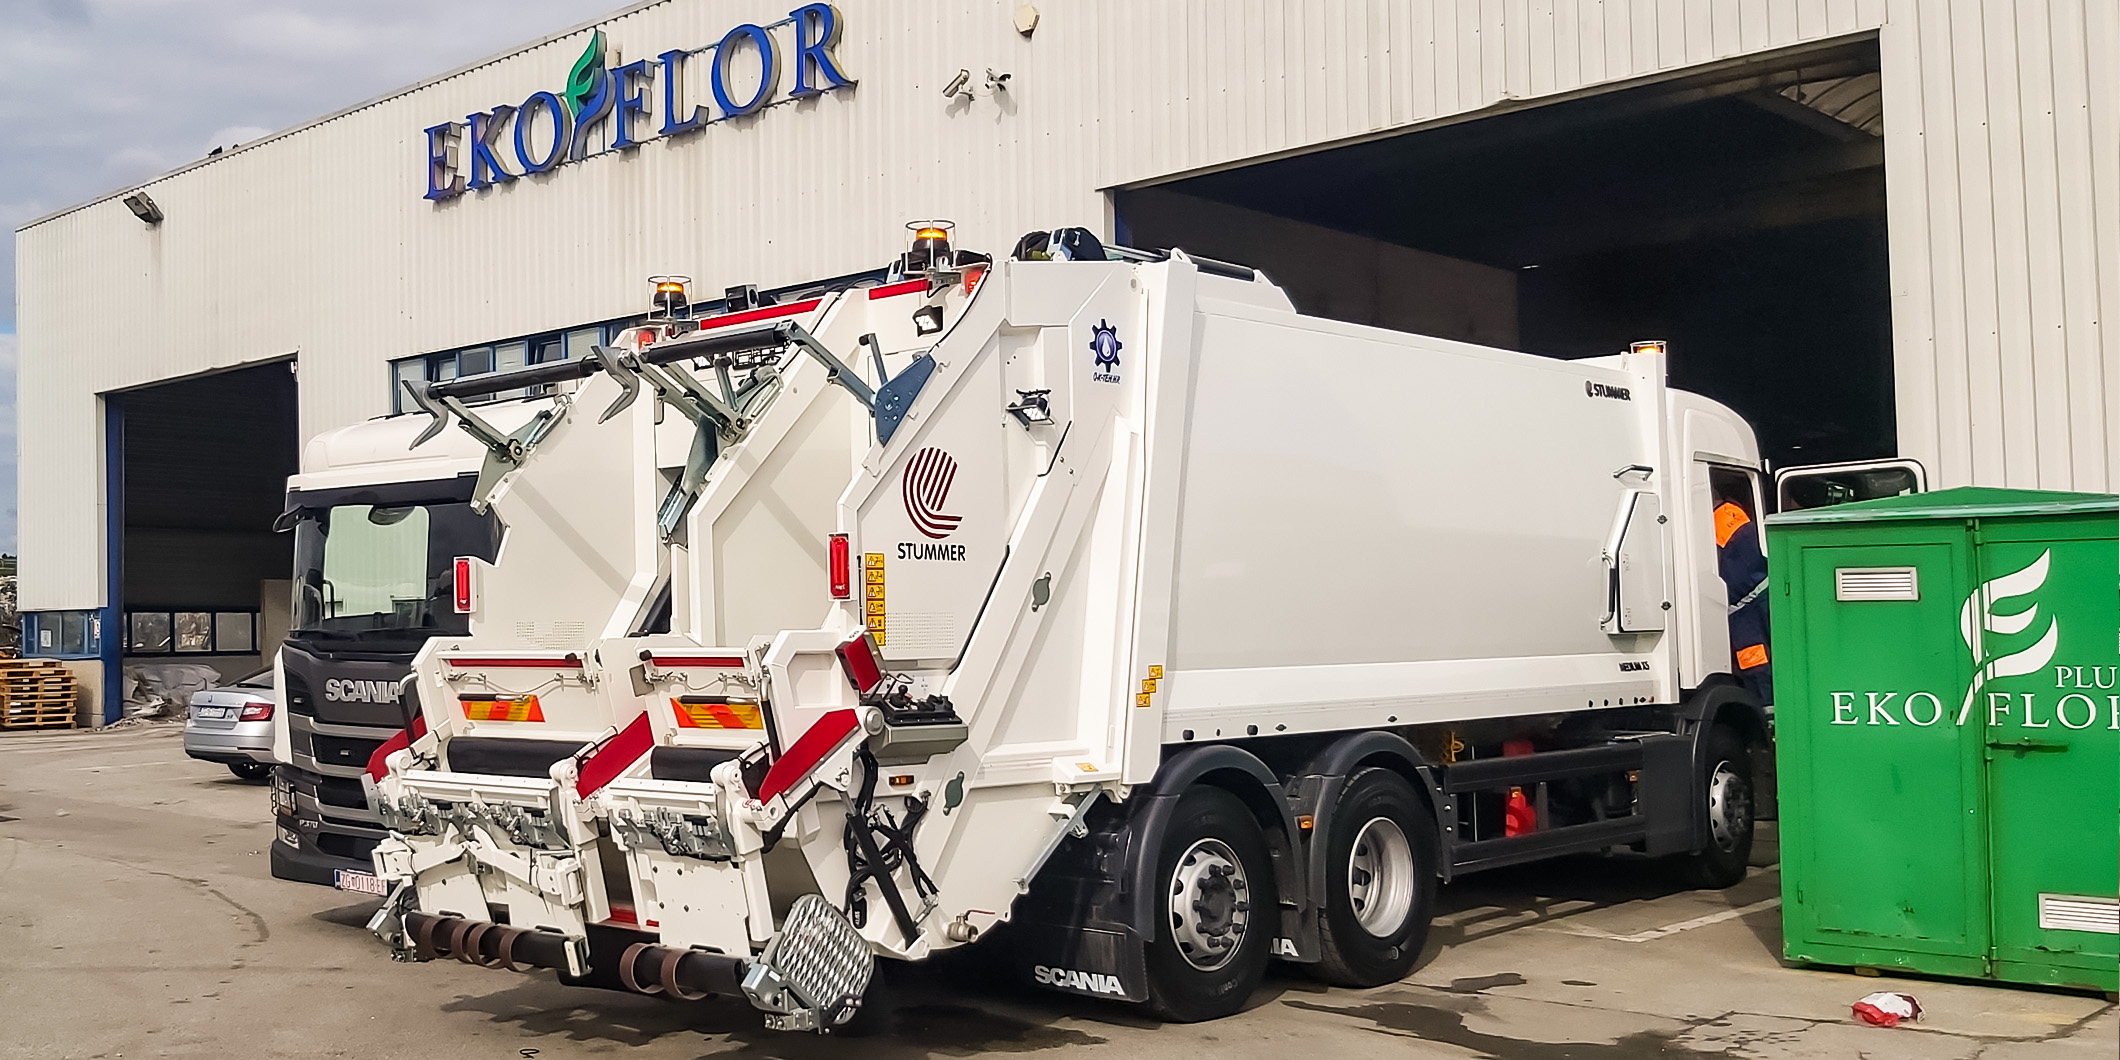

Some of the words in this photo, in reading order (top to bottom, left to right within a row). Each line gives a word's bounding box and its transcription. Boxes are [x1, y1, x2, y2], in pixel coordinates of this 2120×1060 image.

[423, 91, 571, 200] EKO
[611, 2, 857, 149] FLOR
[1593, 383, 1631, 401] STUMMER
[898, 543, 966, 561] STUMMER
[325, 678, 401, 705] SCANIA
[1830, 691, 1943, 727] EKO
[1034, 965, 1126, 996] SCANIA
